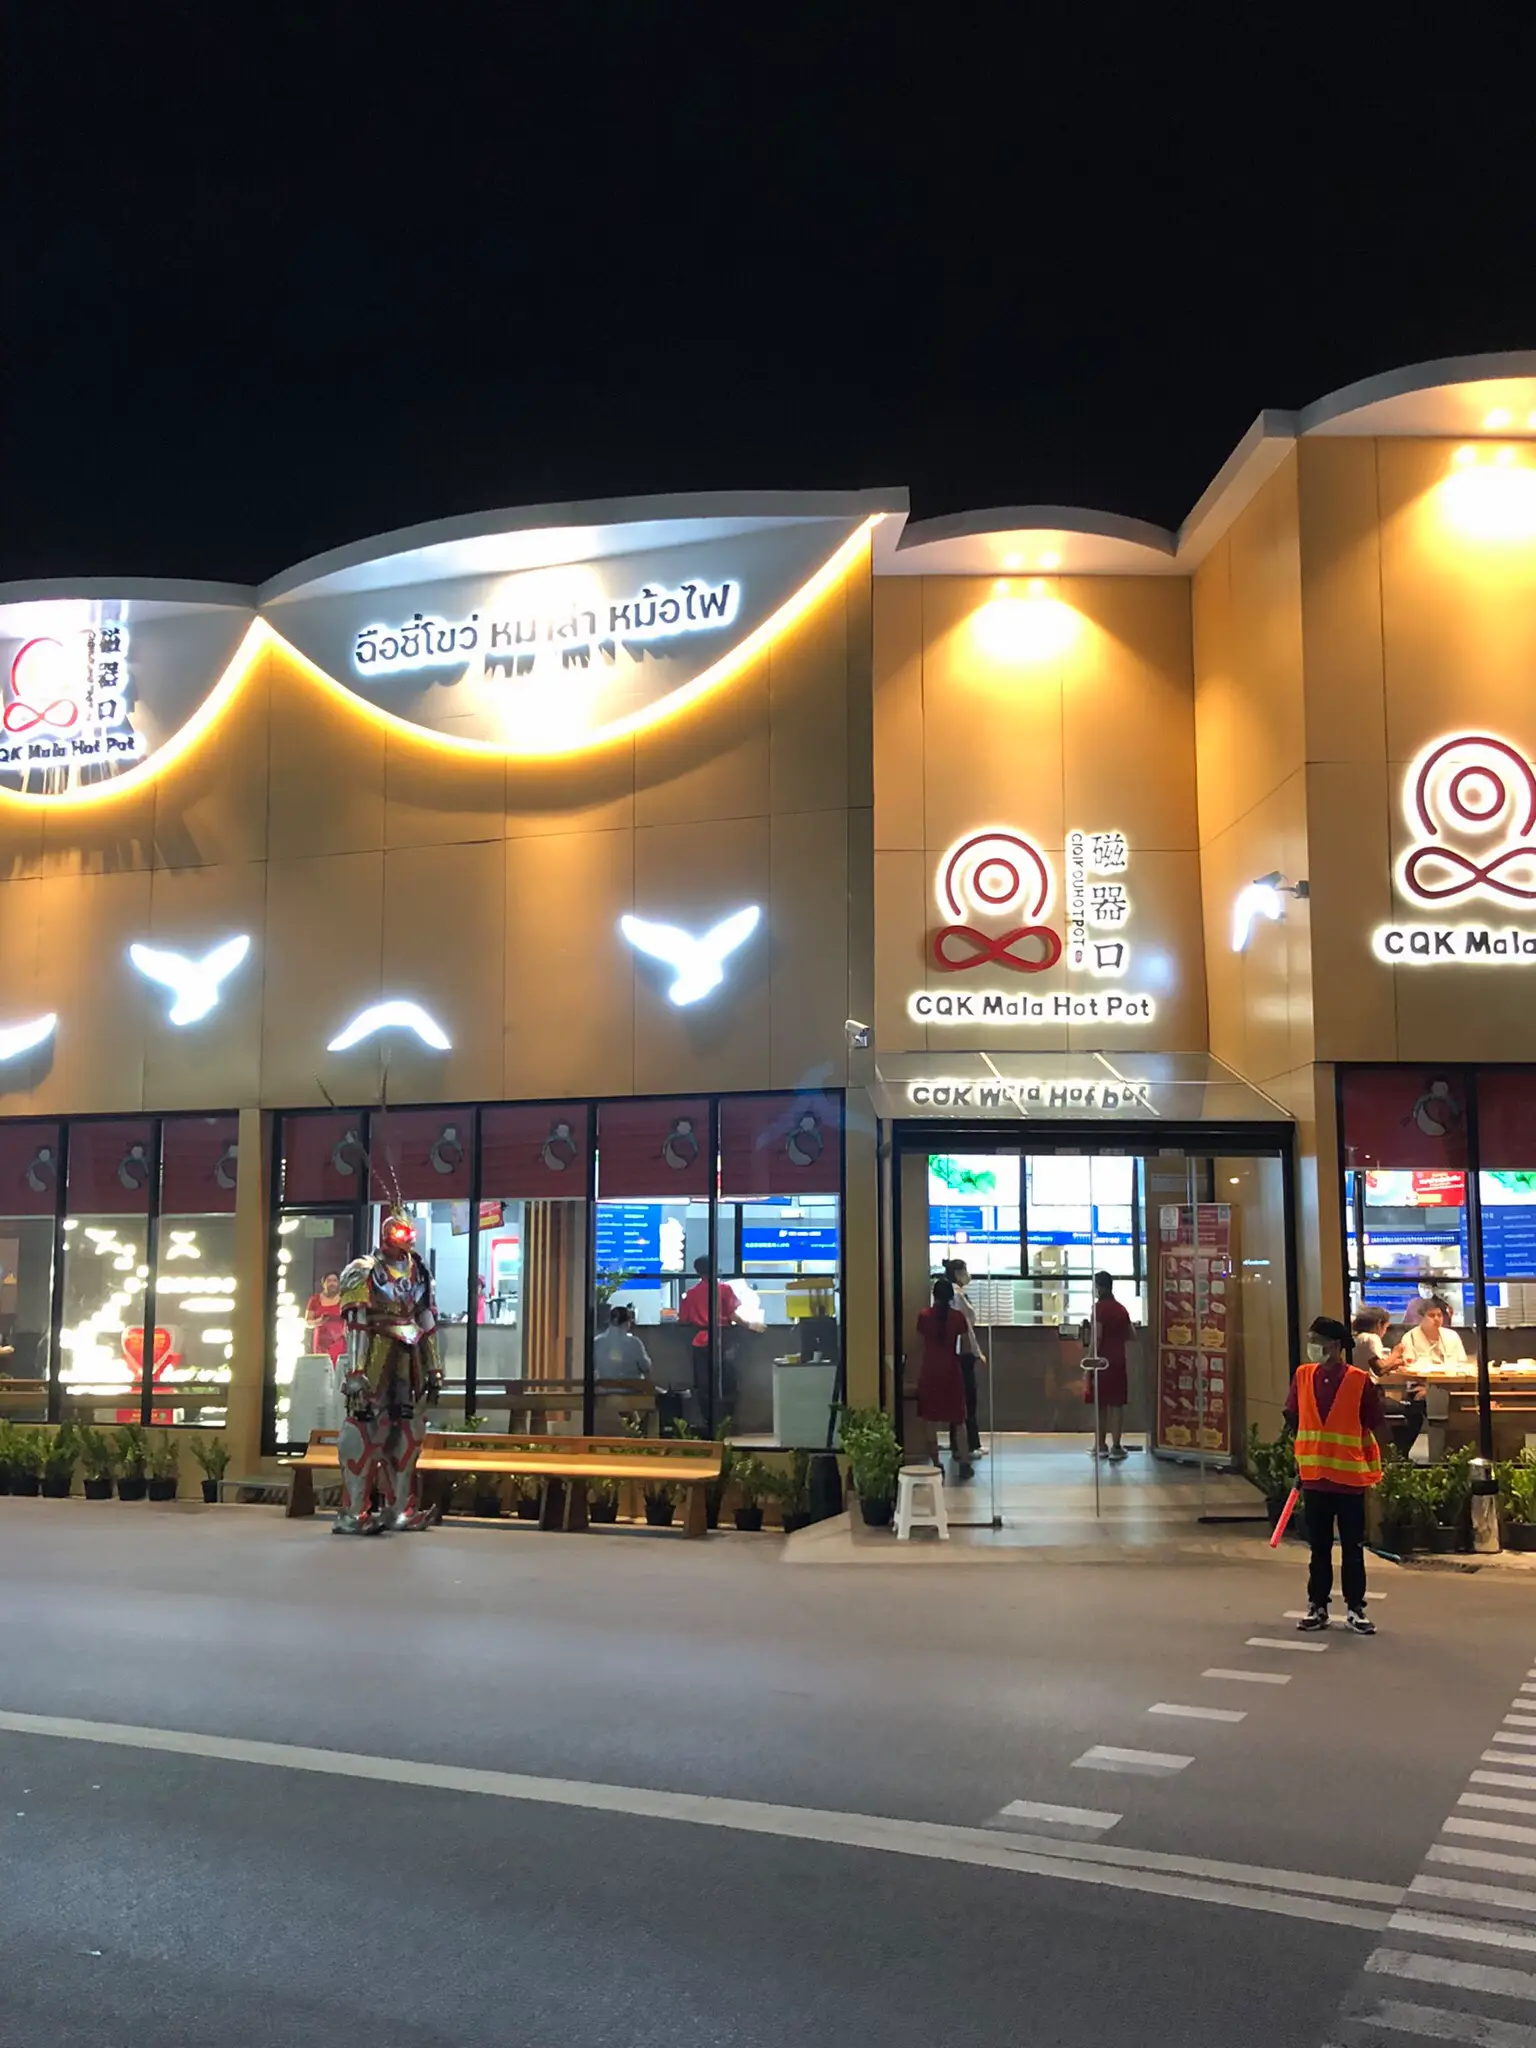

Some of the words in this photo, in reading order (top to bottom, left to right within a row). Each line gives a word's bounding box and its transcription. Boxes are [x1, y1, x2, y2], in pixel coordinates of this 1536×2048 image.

[609, 584, 731, 632] หม้อไฟ
[71, 738, 101, 756] Hot
[106, 736, 135, 753] Pot
[1091, 833, 1126, 969] 磁器口
[1384, 931, 1456, 955] CQK
[1465, 931, 1536, 954] Mala
[916, 996, 975, 1016] CQK
[982, 996, 1043, 1016] Mala
[1054, 996, 1098, 1016] Hot
[1107, 996, 1149, 1016] Pot
